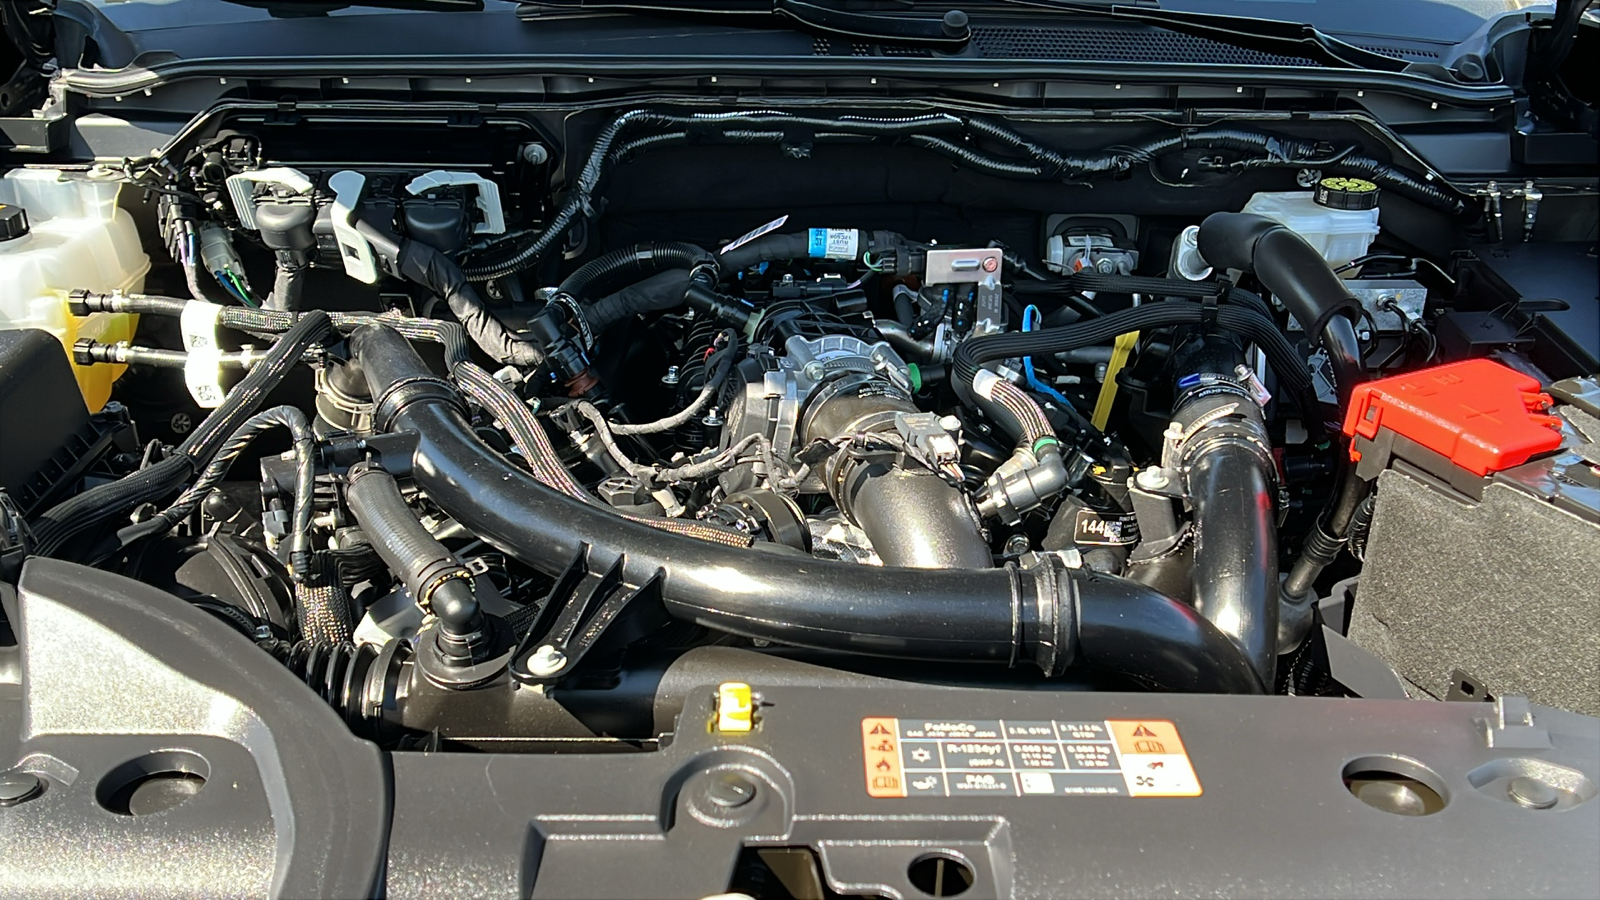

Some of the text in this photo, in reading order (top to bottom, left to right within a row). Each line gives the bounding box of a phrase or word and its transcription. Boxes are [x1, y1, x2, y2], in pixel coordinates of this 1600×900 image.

[1081, 519, 1105, 534] 144
[924, 722, 976, 732] FoMoCo
[946, 744, 1001, 755] R-1234yf
